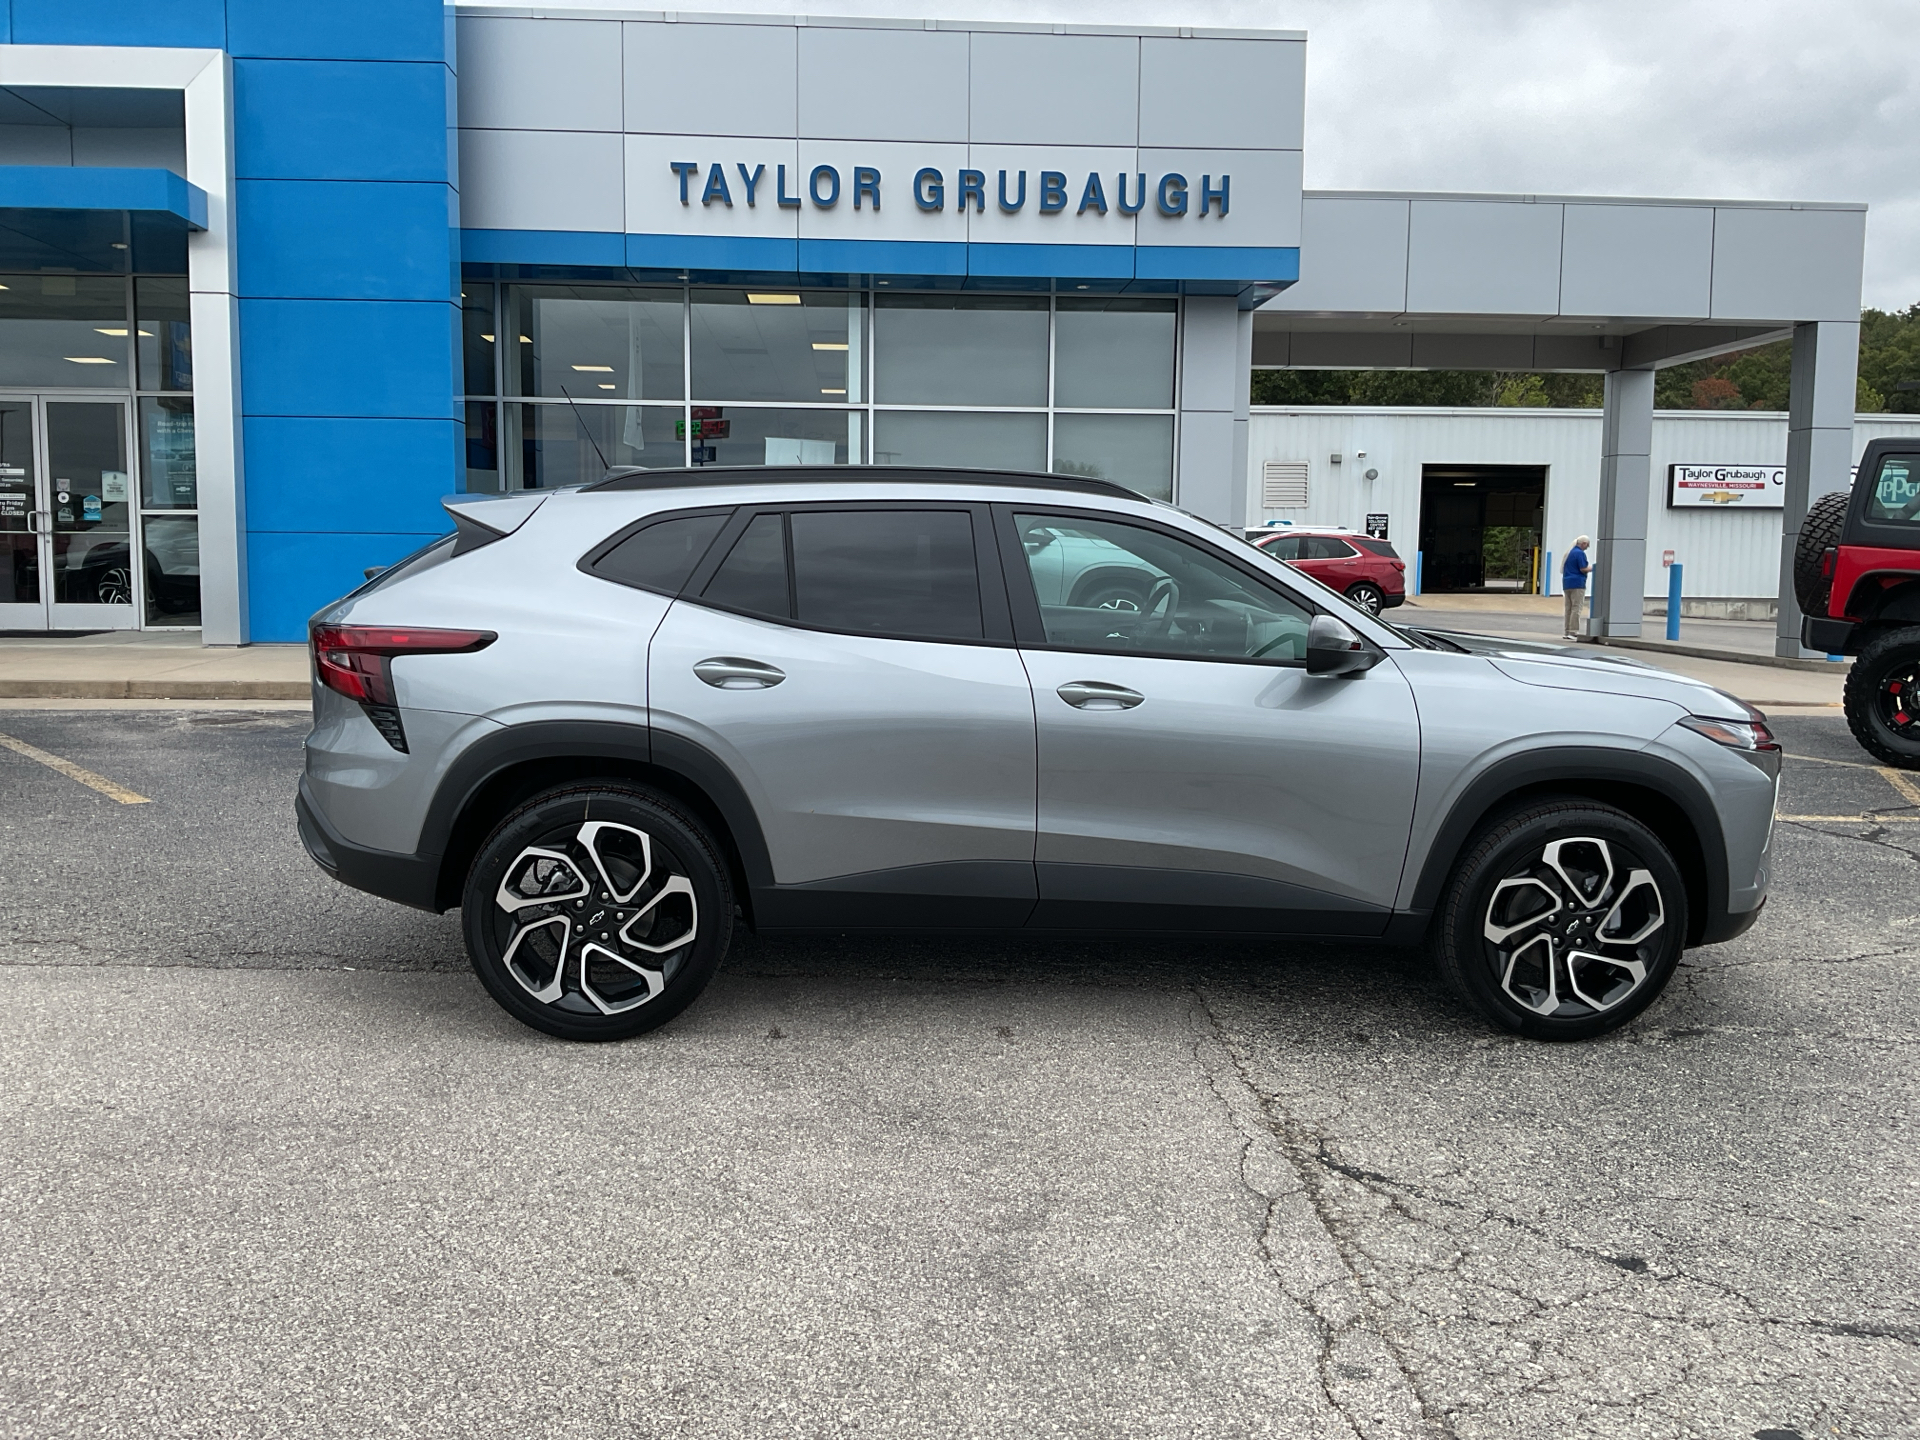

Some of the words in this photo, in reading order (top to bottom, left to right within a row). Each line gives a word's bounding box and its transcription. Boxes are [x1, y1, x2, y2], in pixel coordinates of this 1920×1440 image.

[669, 161, 882, 211] TAYLOR
[912, 167, 1231, 218] GRUBAUGH
[1679, 468, 1713, 480] Taylor
[1714, 468, 1766, 481] Grubaugh
